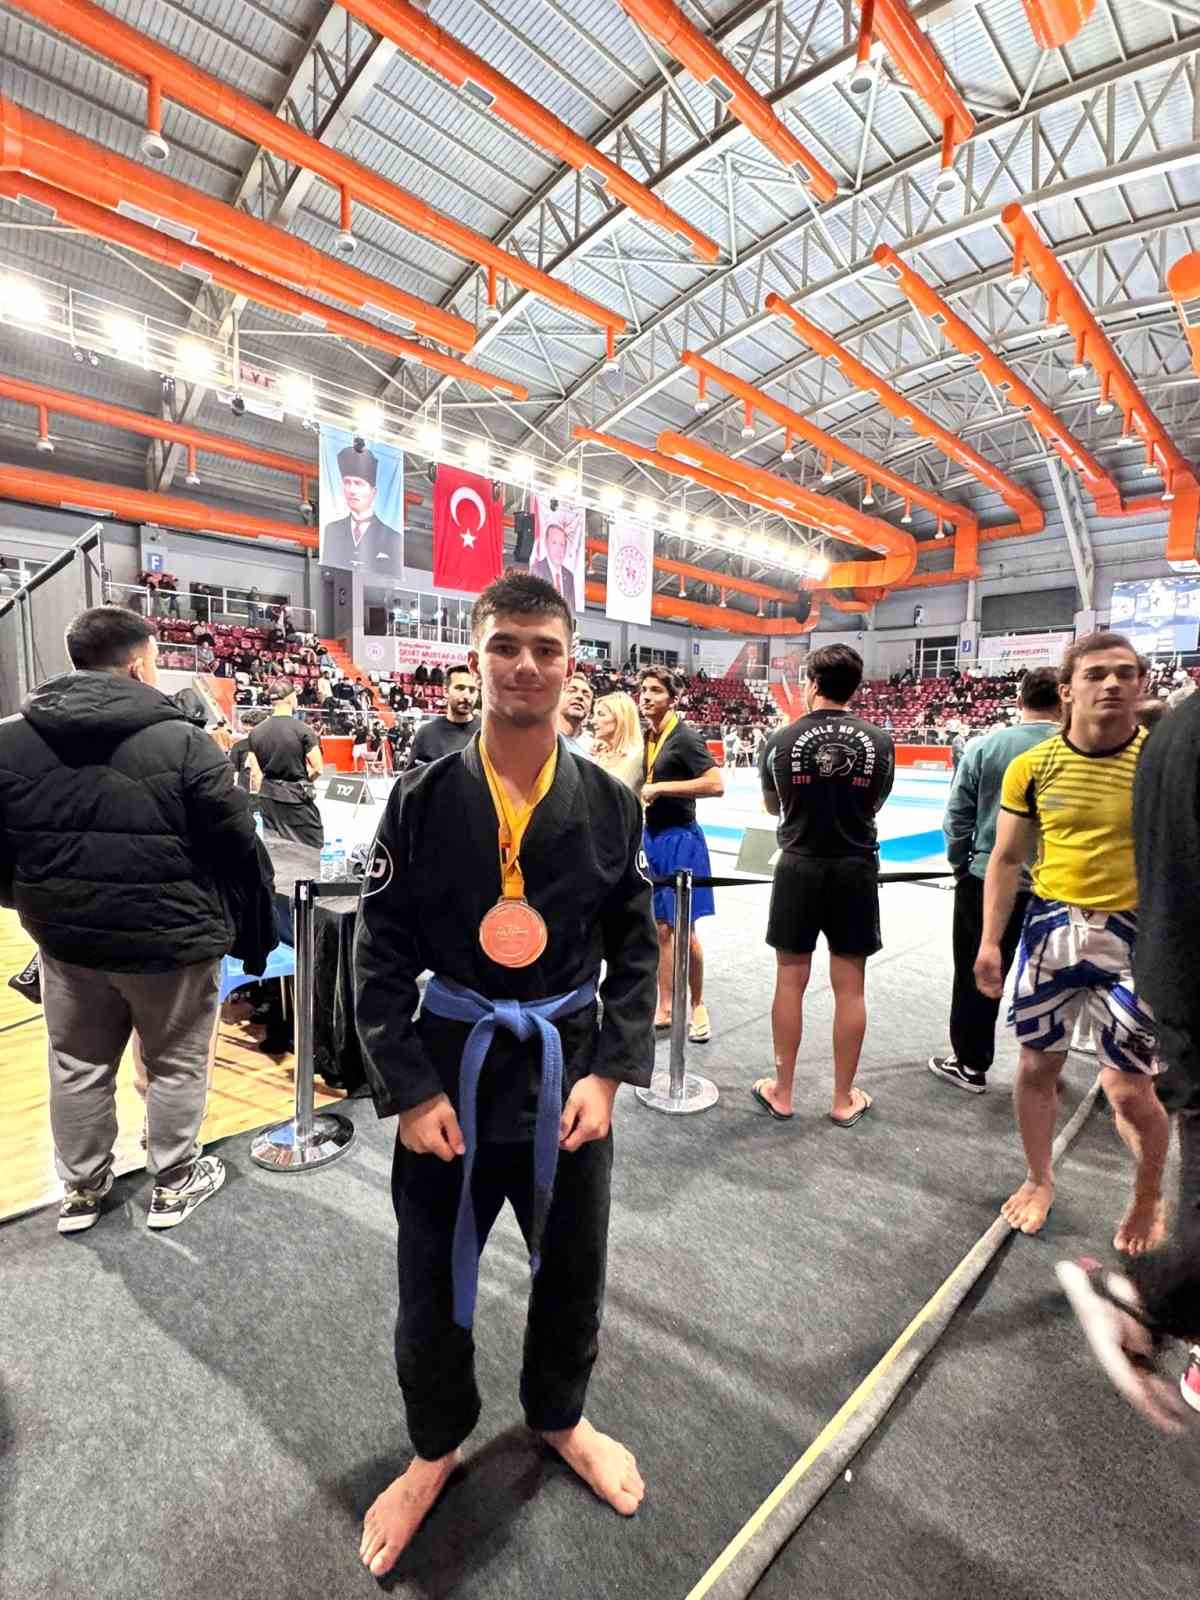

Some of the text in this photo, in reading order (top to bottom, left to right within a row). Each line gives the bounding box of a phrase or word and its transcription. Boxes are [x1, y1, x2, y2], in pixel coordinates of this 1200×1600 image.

[839, 725, 855, 734] NO
[791, 725, 834, 758] STRUGGLE
[855, 730, 876, 775] PROGRESS
[791, 761, 801, 772] NO
